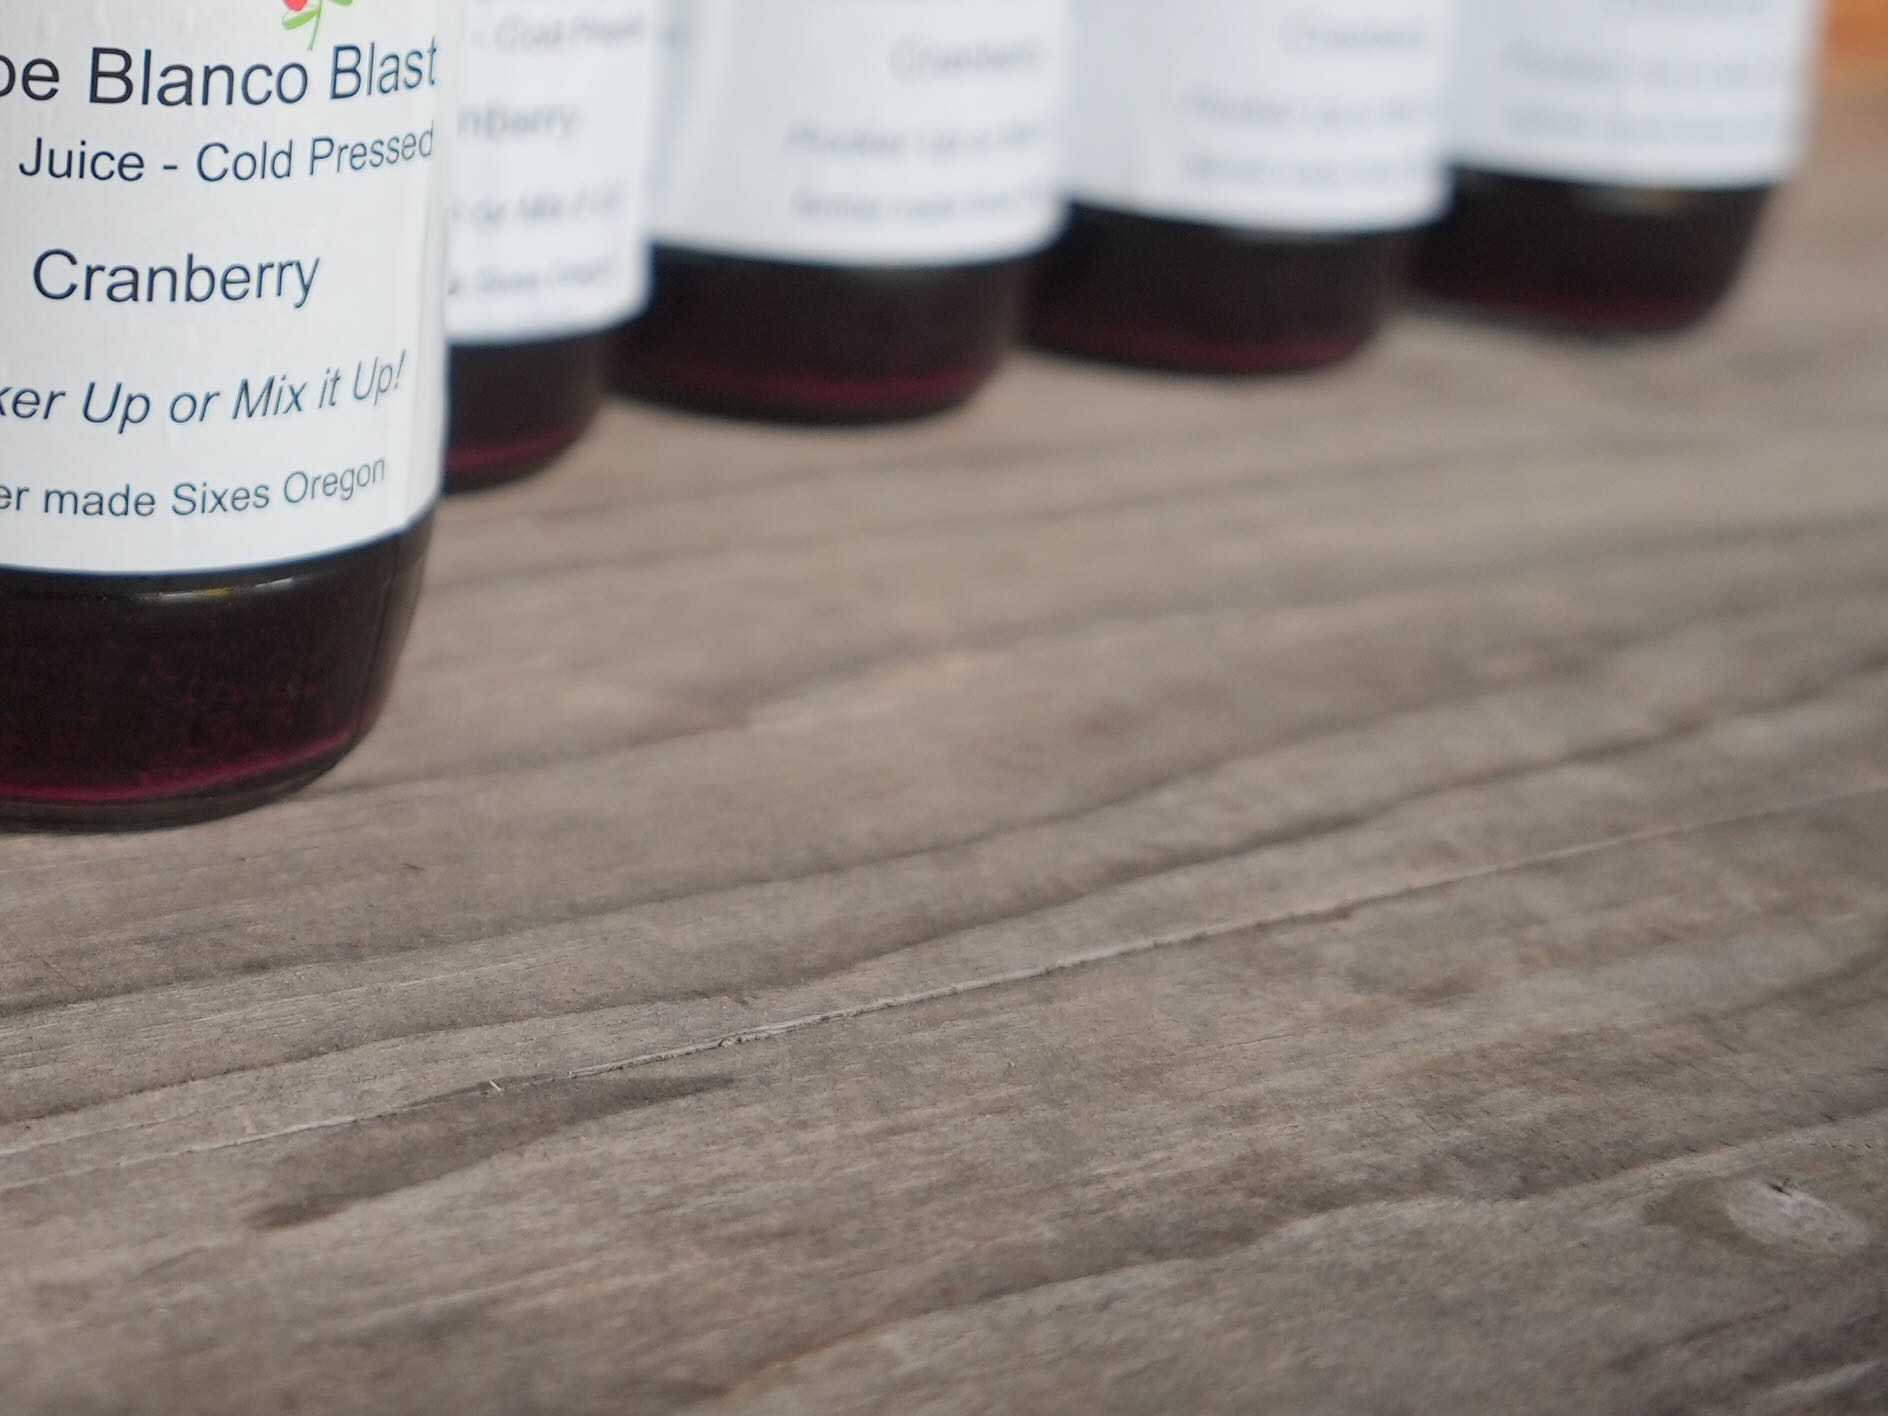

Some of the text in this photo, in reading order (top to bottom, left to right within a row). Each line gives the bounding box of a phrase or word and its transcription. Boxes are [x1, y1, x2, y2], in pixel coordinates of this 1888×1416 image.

[89, 46, 309, 107] Blanco
[330, 36, 437, 101] Blast
[18, 136, 145, 182] Juice
[196, 139, 293, 182] Cold
[309, 120, 434, 176] Pressed
[33, 248, 320, 309] Cranberry
[82, 381, 151, 435] Up
[169, 391, 221, 424] or
[232, 374, 307, 420] Mix
[318, 368, 340, 408] it
[352, 350, 406, 406] Up!
[44, 483, 156, 517] made
[171, 481, 270, 516] Sixes
[283, 459, 385, 504] Oregon
